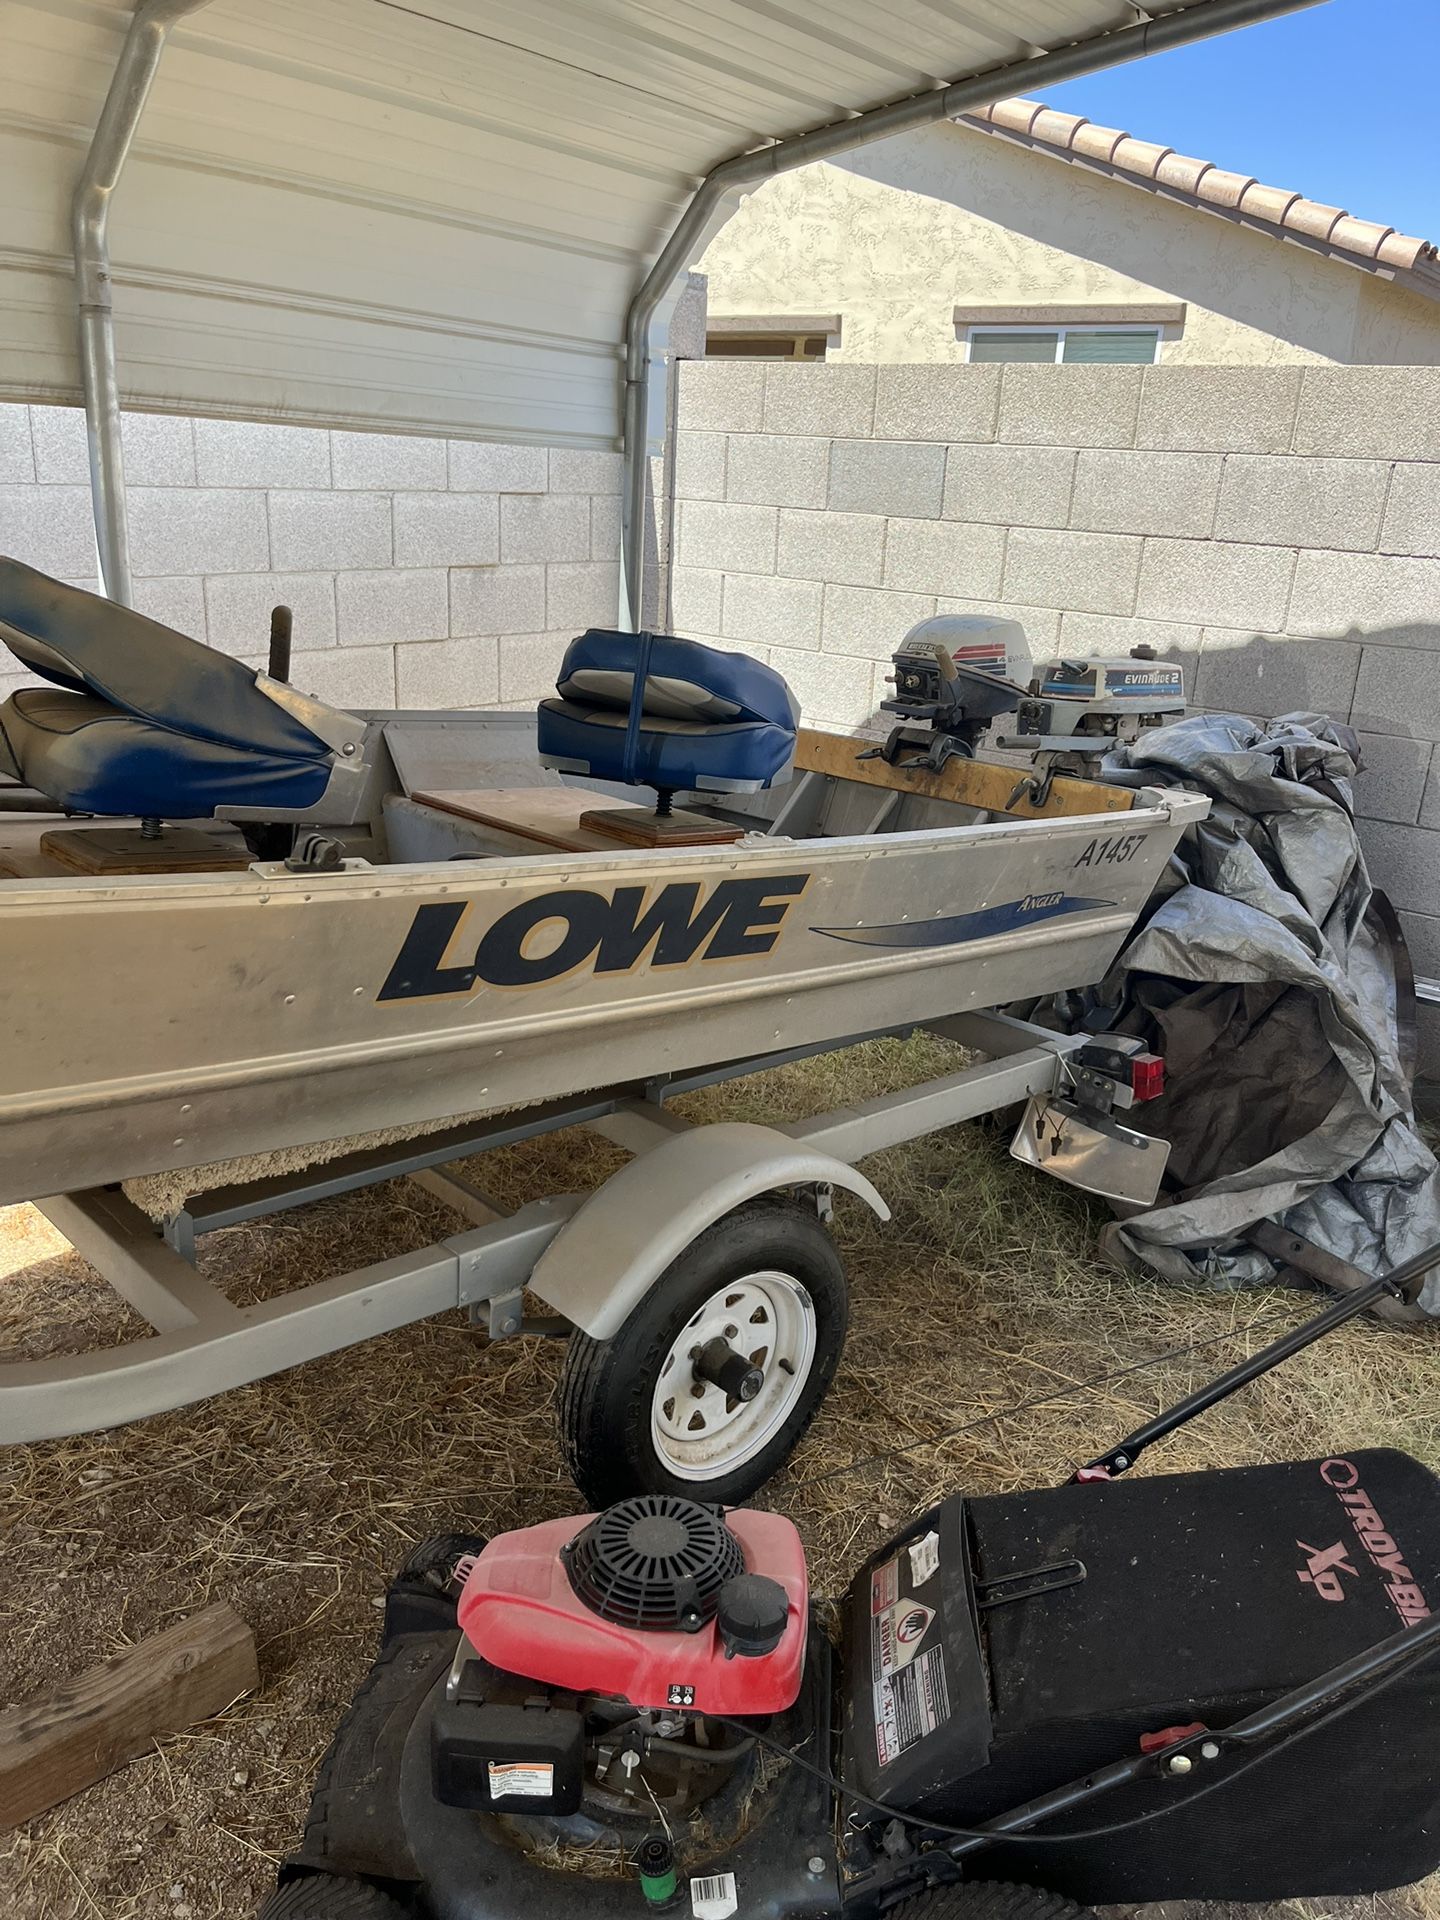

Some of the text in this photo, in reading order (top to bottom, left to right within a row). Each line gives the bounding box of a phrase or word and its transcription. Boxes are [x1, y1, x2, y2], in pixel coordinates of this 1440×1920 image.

[1124, 672, 1180, 685] EVINRUDE 2
[1074, 834, 1148, 867] A1457
[1016, 892, 1063, 912] ANGLER
[376, 873, 815, 1006] LOWE
[881, 1617, 891, 1667] DANGER
